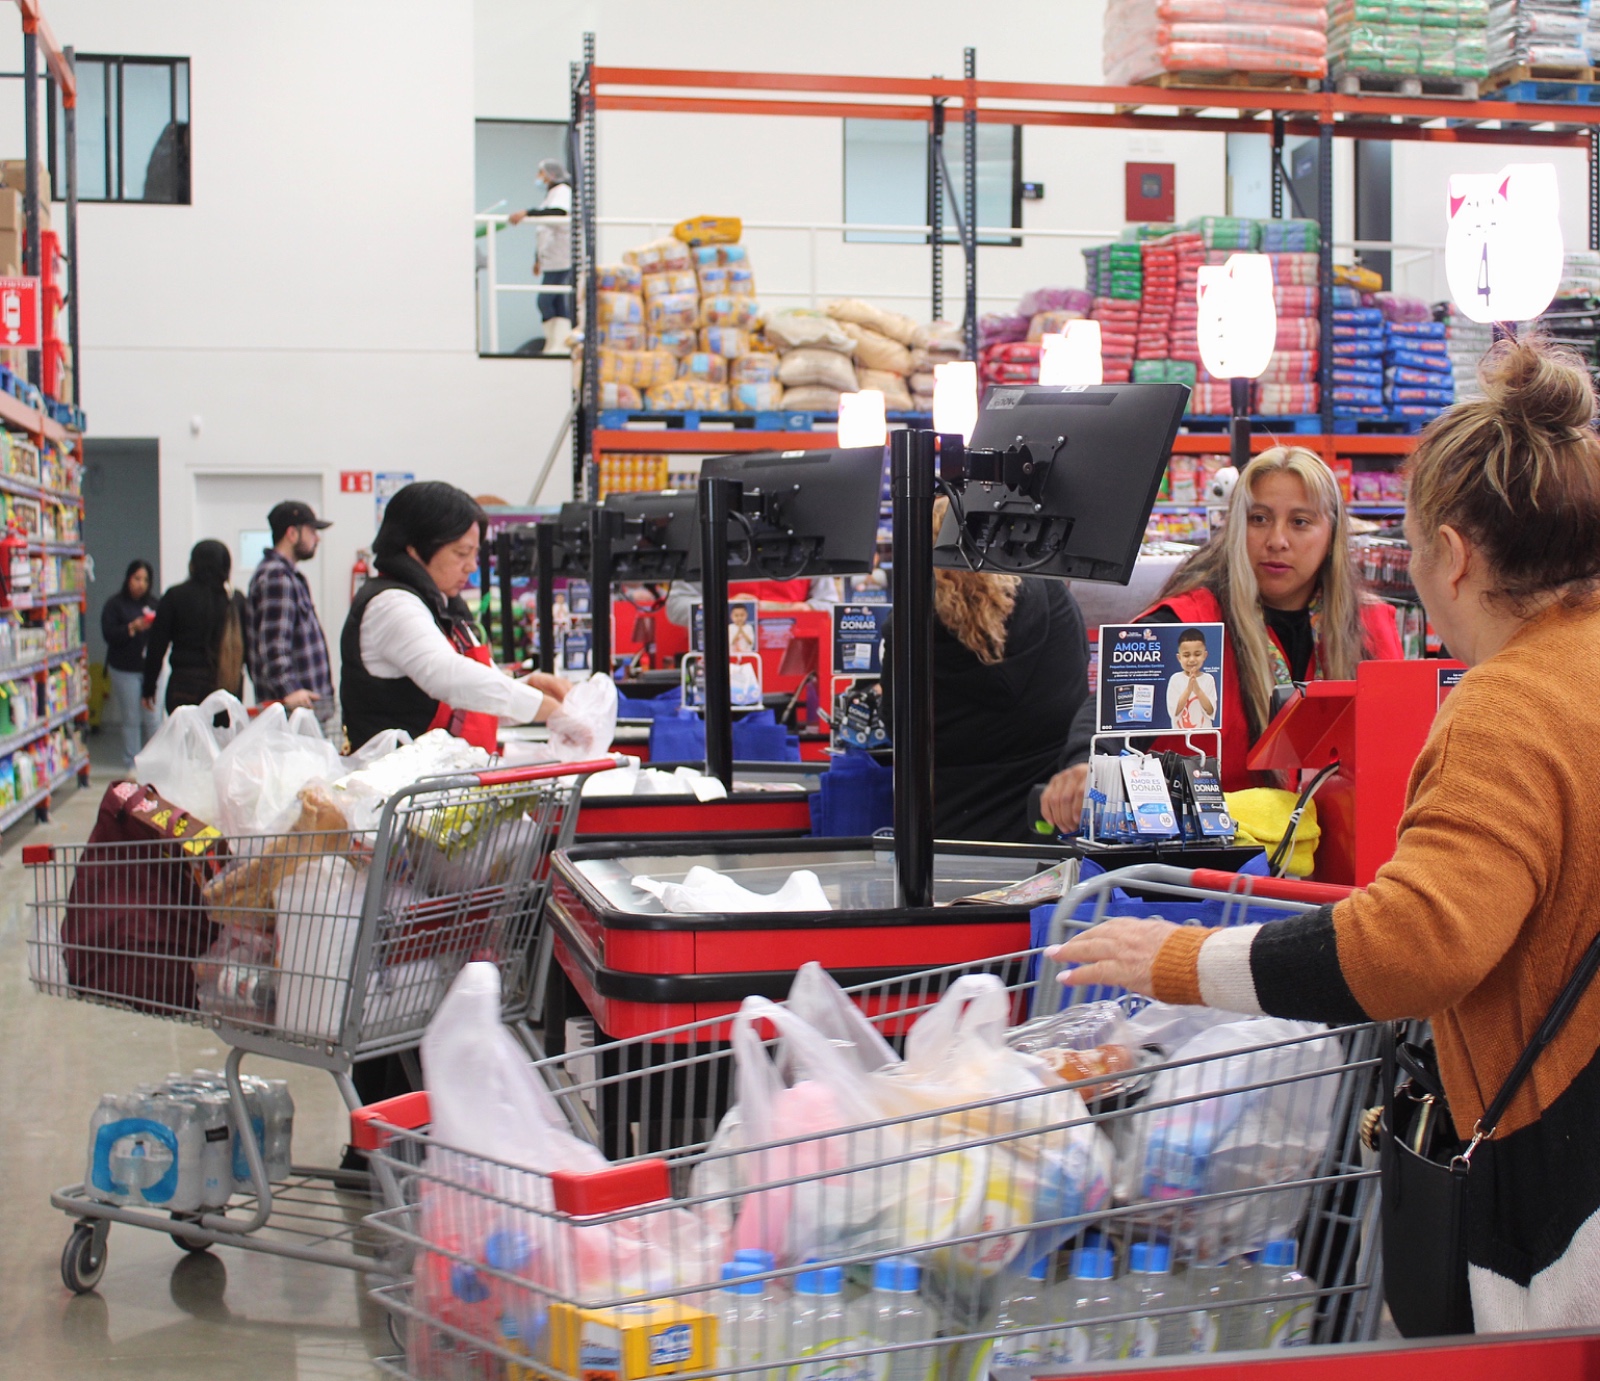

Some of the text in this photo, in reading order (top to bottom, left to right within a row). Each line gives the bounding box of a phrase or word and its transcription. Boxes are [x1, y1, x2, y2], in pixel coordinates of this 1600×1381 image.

[840, 621, 876, 630] DONAR
[1114, 642, 1161, 651] AMOR ES
[1113, 651, 1161, 663] DONAR
[1131, 784, 1162, 792] DONAR
[1194, 784, 1220, 793] DONAR
